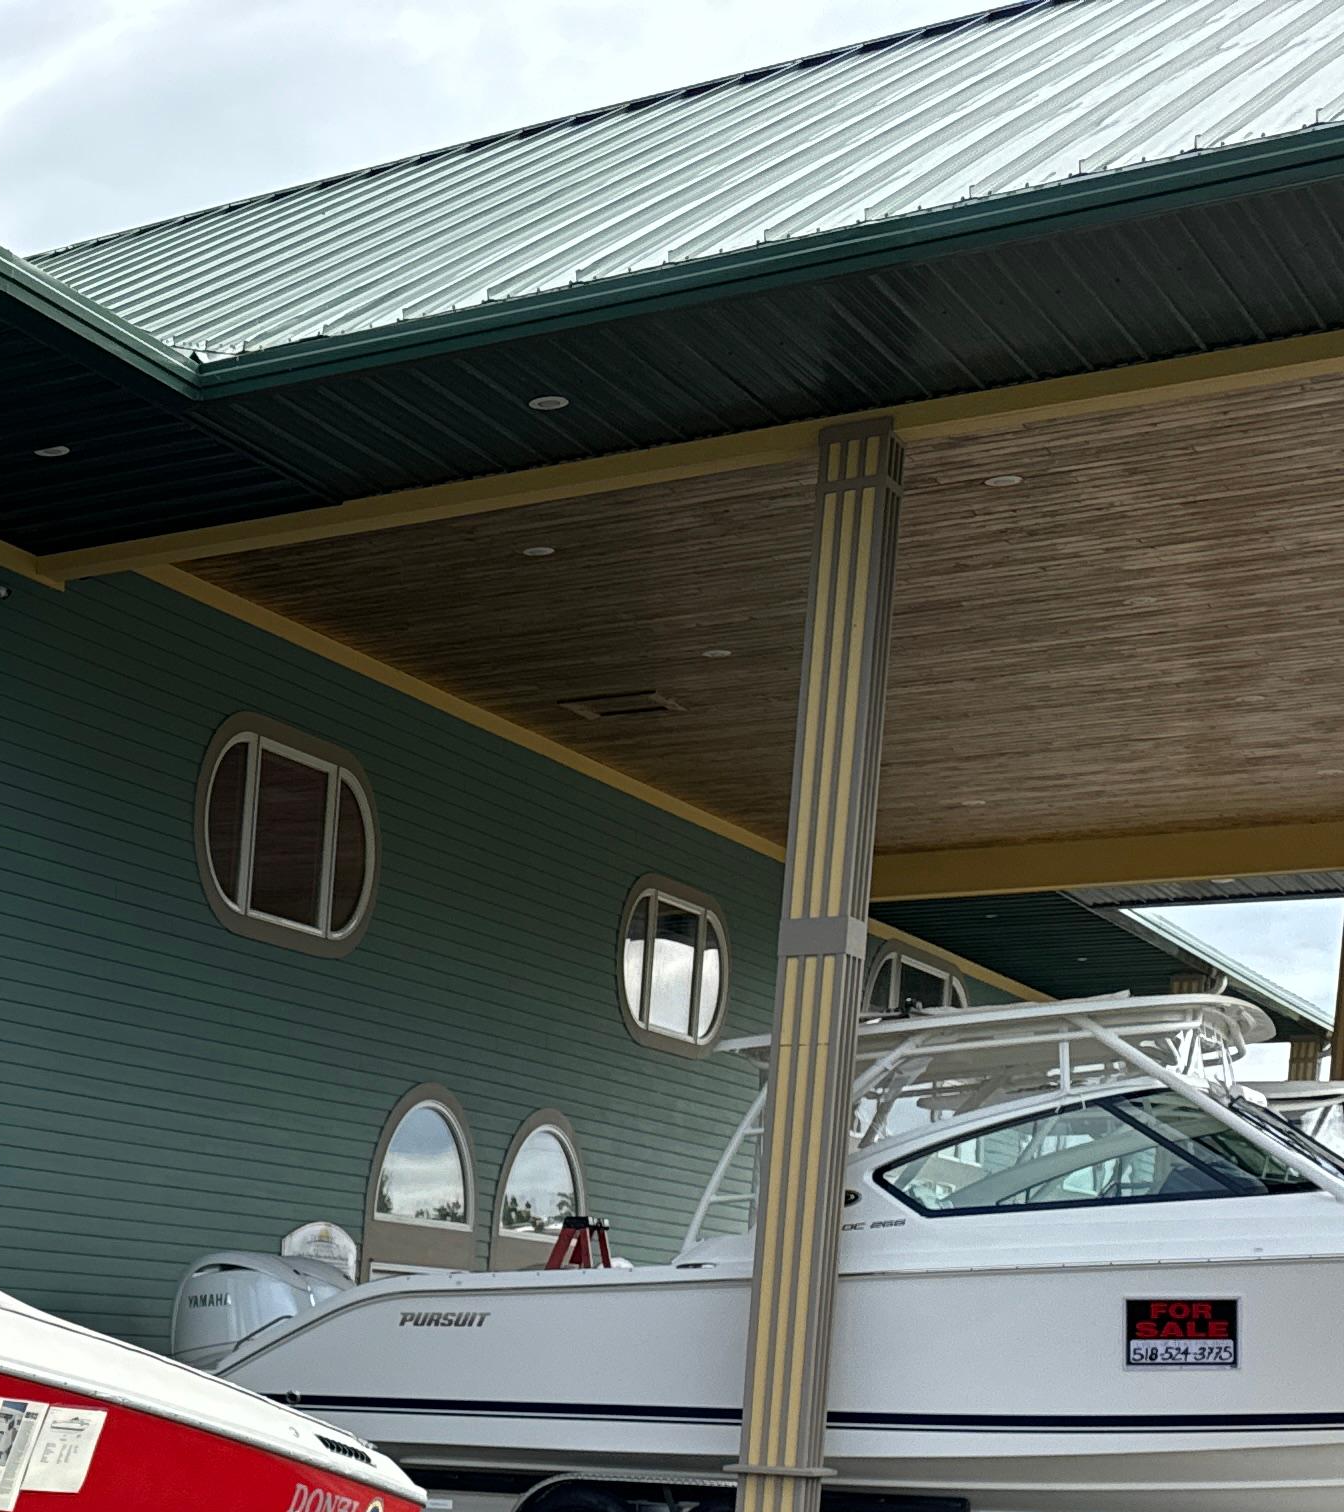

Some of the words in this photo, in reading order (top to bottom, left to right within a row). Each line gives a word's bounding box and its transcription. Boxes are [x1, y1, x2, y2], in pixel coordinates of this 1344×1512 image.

[1150, 1302, 1212, 1319] FOR
[399, 1312, 491, 1328] PURSUIT
[1135, 1321, 1229, 1337] SALE
